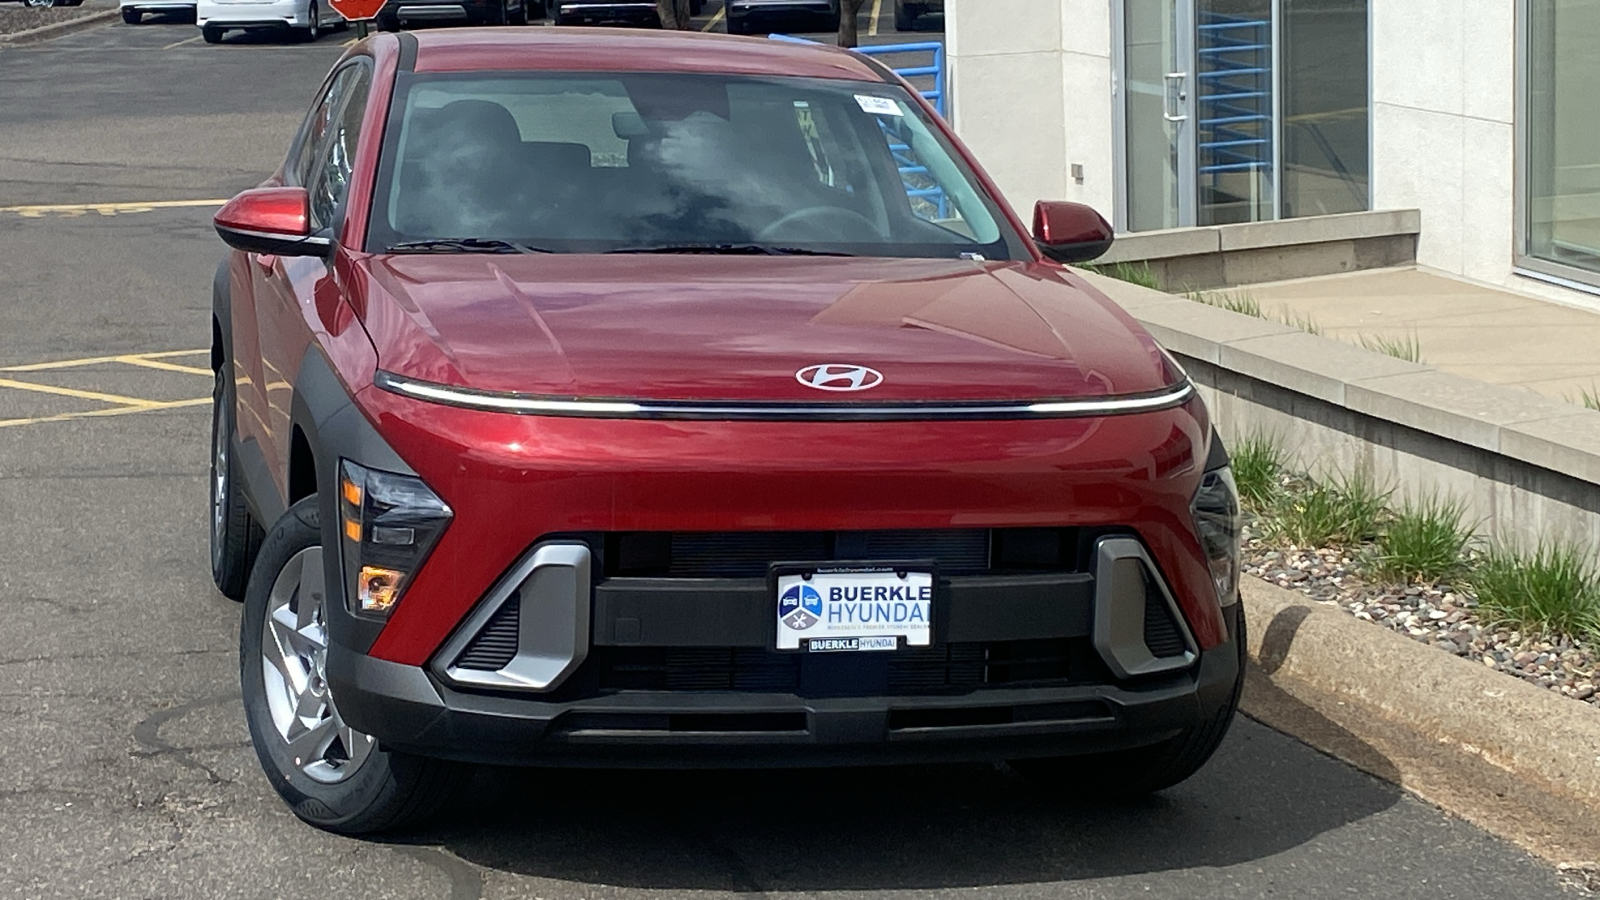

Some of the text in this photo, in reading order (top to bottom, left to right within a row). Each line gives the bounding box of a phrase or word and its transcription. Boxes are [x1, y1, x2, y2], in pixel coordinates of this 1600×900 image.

[829, 586, 931, 602] BUERKLE
[828, 603, 930, 623] HYUNDAI
[811, 638, 895, 650] BUERKLE HYUNDAI
